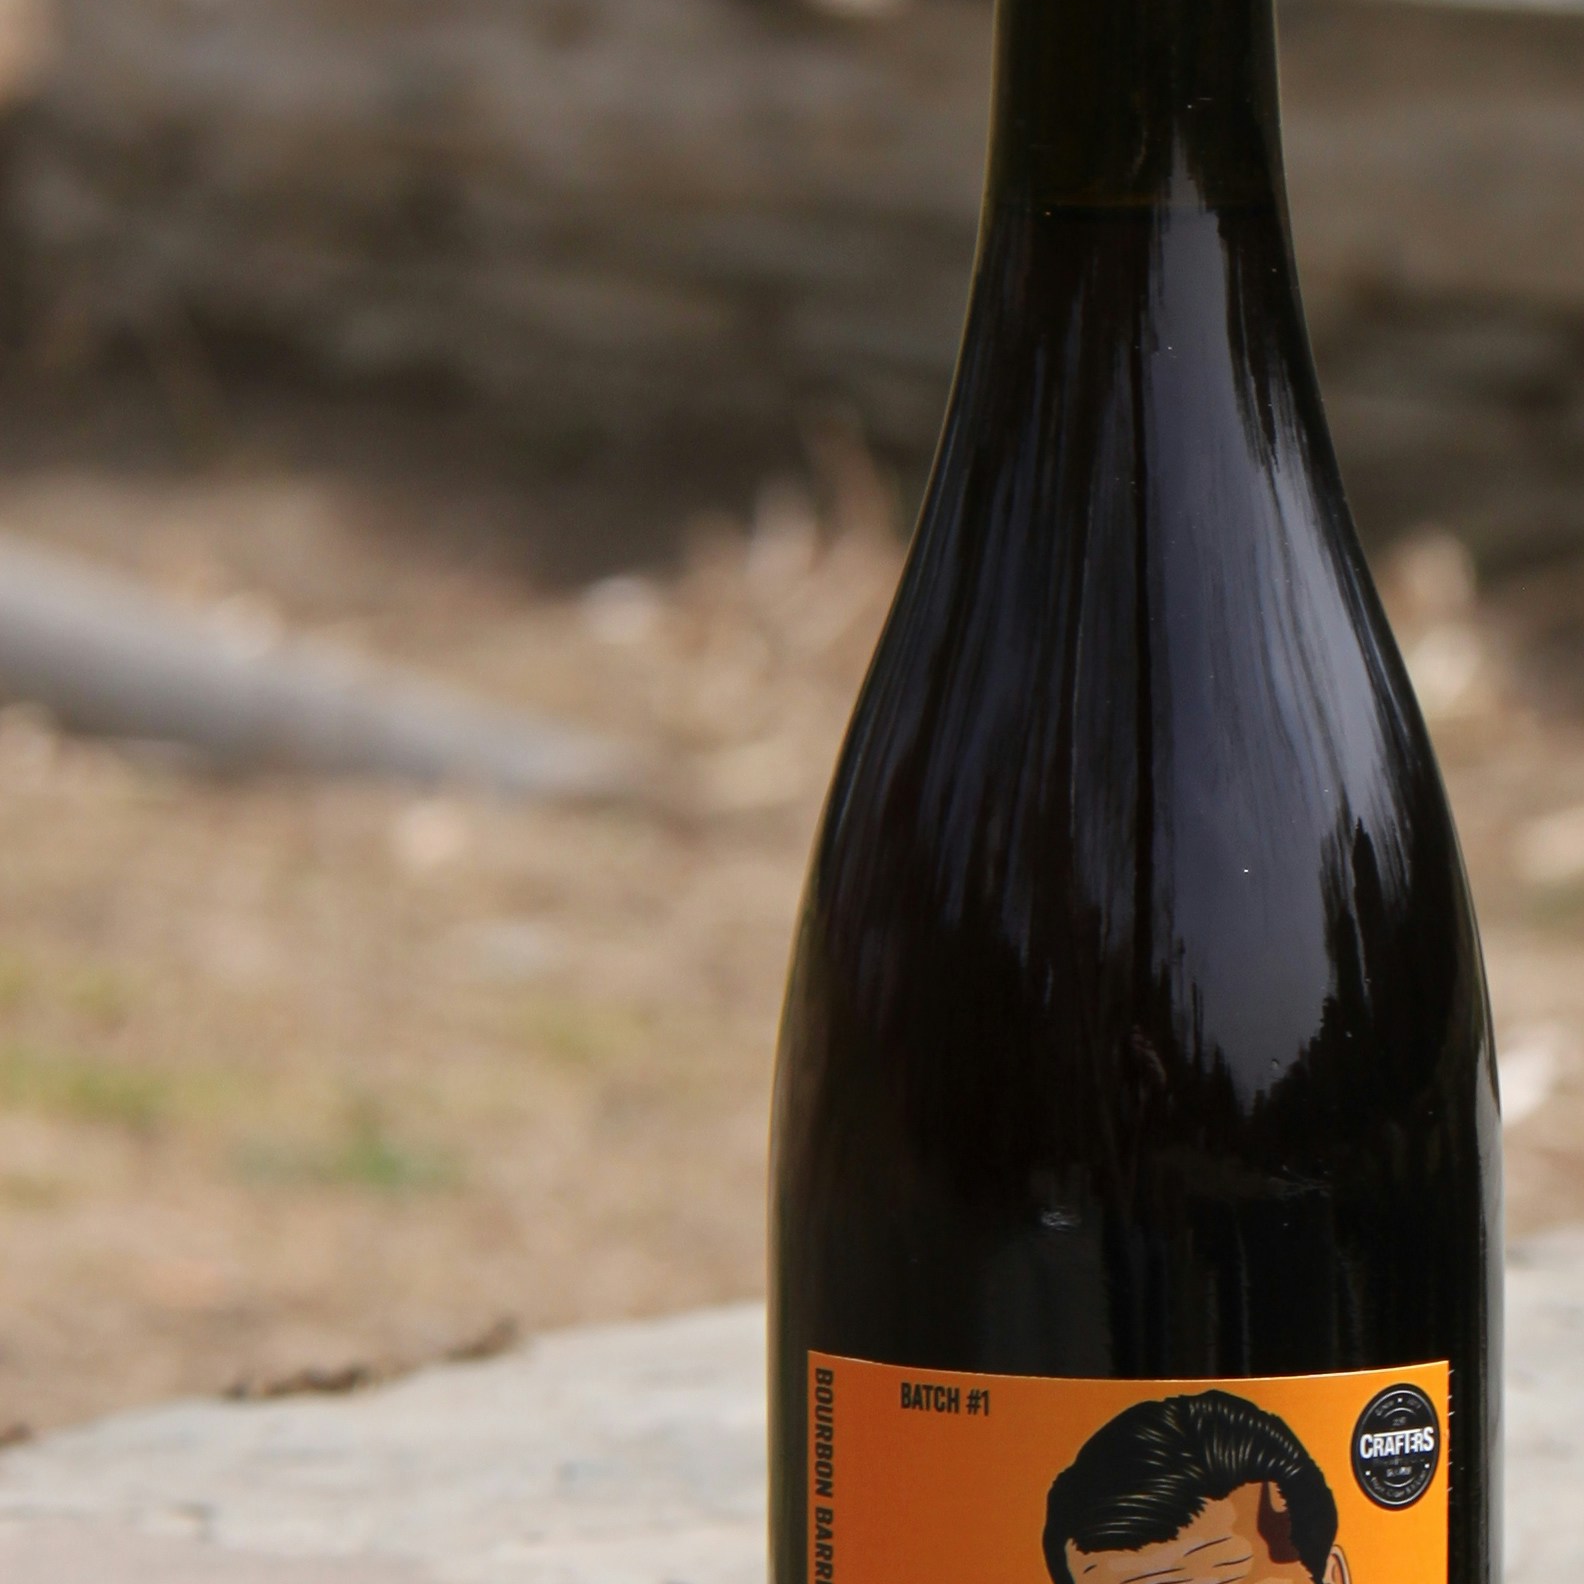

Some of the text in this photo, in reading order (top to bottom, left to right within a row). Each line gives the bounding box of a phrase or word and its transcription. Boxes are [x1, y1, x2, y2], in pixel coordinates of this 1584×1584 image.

[900, 1382, 990, 1416] BATCH #1
[814, 1368, 834, 1498] BOURBON
[1360, 1426, 1435, 1459] CRAFTERS
